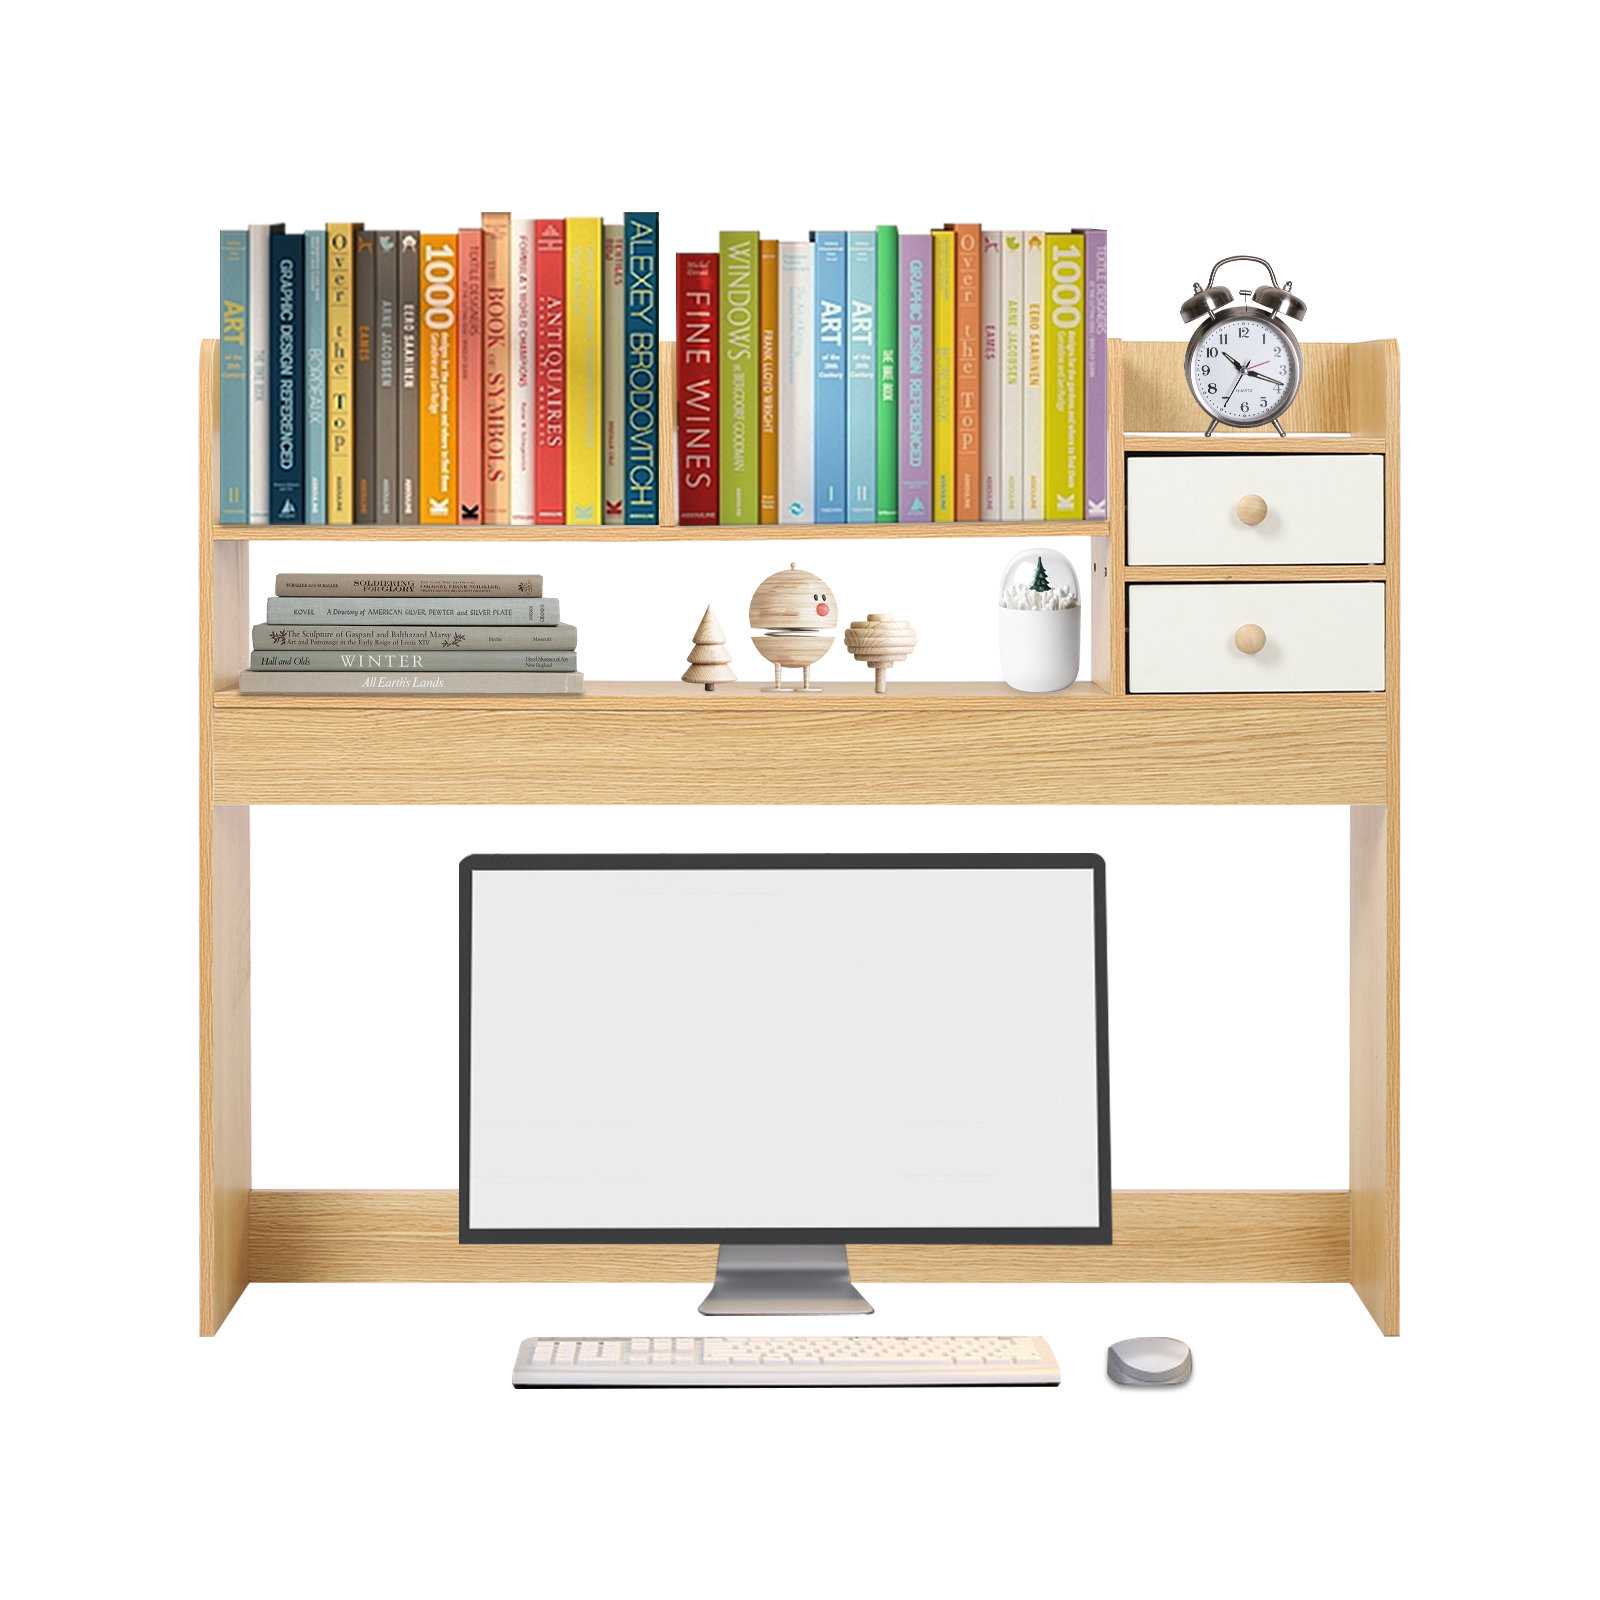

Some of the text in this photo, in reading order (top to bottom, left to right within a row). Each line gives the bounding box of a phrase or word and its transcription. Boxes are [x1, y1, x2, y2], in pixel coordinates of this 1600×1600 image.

[613, 238, 623, 286] TEXTILES
[629, 219, 654, 325] ALEXEY
[280, 258, 294, 321] GRAPHIC
[424, 244, 456, 330] 1000
[469, 246, 480, 336] TEXTILE DESIGNERS
[909, 258, 924, 321] GRAPHIC
[1051, 244, 1082, 329] 1000
[1096, 245, 1106, 336] TEXTILE DESIGNERS
[223, 300, 246, 346] ART
[487, 287, 506, 348] BOOK
[519, 235, 528, 387] FORMULA WORLD CHAMPIONS
[685, 291, 711, 364] FINE
[820, 300, 843, 346] ART
[851, 300, 873, 346] ART
[280, 324, 294, 375] DESIGN
[359, 326, 371, 361] EAMES
[381, 301, 392, 388] ARNE JACOBSEN
[404, 304, 415, 389] EERO SAARINEN
[440, 332, 449, 358] designs
[909, 324, 924, 374] DESIGN
[961, 233, 976, 451] Over the Top
[985, 325, 996, 361] EAMES
[1007, 300, 1018, 385] ARNE JACOBSEN
[1029, 303, 1040, 387] EERO SAARINEN
[1066, 331, 1076, 356] designs
[1219, 333, 1228, 345] 11
[1238, 327, 1250, 338] 12
[1262, 333, 1266, 345] 1
[727, 240, 753, 472] WINDOWS BERGDORF GOODMAN
[1068, 357, 1076, 367] for
[1201, 364, 1211, 376] 9
[1206, 346, 1218, 358] 10
[1273, 346, 1282, 358] 2
[1279, 364, 1287, 376] 3
[308, 348, 322, 424] BORDEAUX
[544, 296, 562, 448] ANTIQUAIRES
[762, 329, 774, 434] FRANK LLOYD WRIGHT
[882, 349, 894, 402] THE BIKE BOOK
[1068, 369, 1077, 380] the
[1207, 383, 1218, 394] 8
[1272, 384, 1283, 394] 4
[439, 384, 449, 412] gardens
[1066, 382, 1076, 409] gardens
[1240, 402, 1250, 412] 6
[1259, 396, 1268, 408] 5
[280, 379, 294, 470] REFERENCED
[441, 413, 449, 427] and
[487, 372, 506, 482] SYMBOLS
[629, 332, 654, 505] BRODOVITCH
[685, 379, 711, 489] WINES
[909, 378, 924, 468] REFERENCED
[1068, 411, 1077, 423] and
[1068, 424, 1077, 445] where
[1068, 455, 1077, 469] find
[1068, 471, 1077, 488] them
[441, 475, 449, 492] them
[293, 608, 315, 616] KOVEL
[327, 608, 332, 616] A
[333, 608, 359, 617] Directory
[360, 608, 366, 617] of
[286, 630, 300, 638] The
[302, 630, 334, 639] Sculpture
[335, 630, 344, 638] of
[345, 631, 374, 639] Gaspard
[391, 631, 427, 639] Balthazard
[429, 631, 452, 640] Marsy
[310, 639, 340, 647] Patronage
[358, 639, 373, 647] Early
[260, 657, 311, 666] Hall and Olds
[340, 654, 424, 668] WINTER
[362, 677, 444, 688] All Earth's Lands
